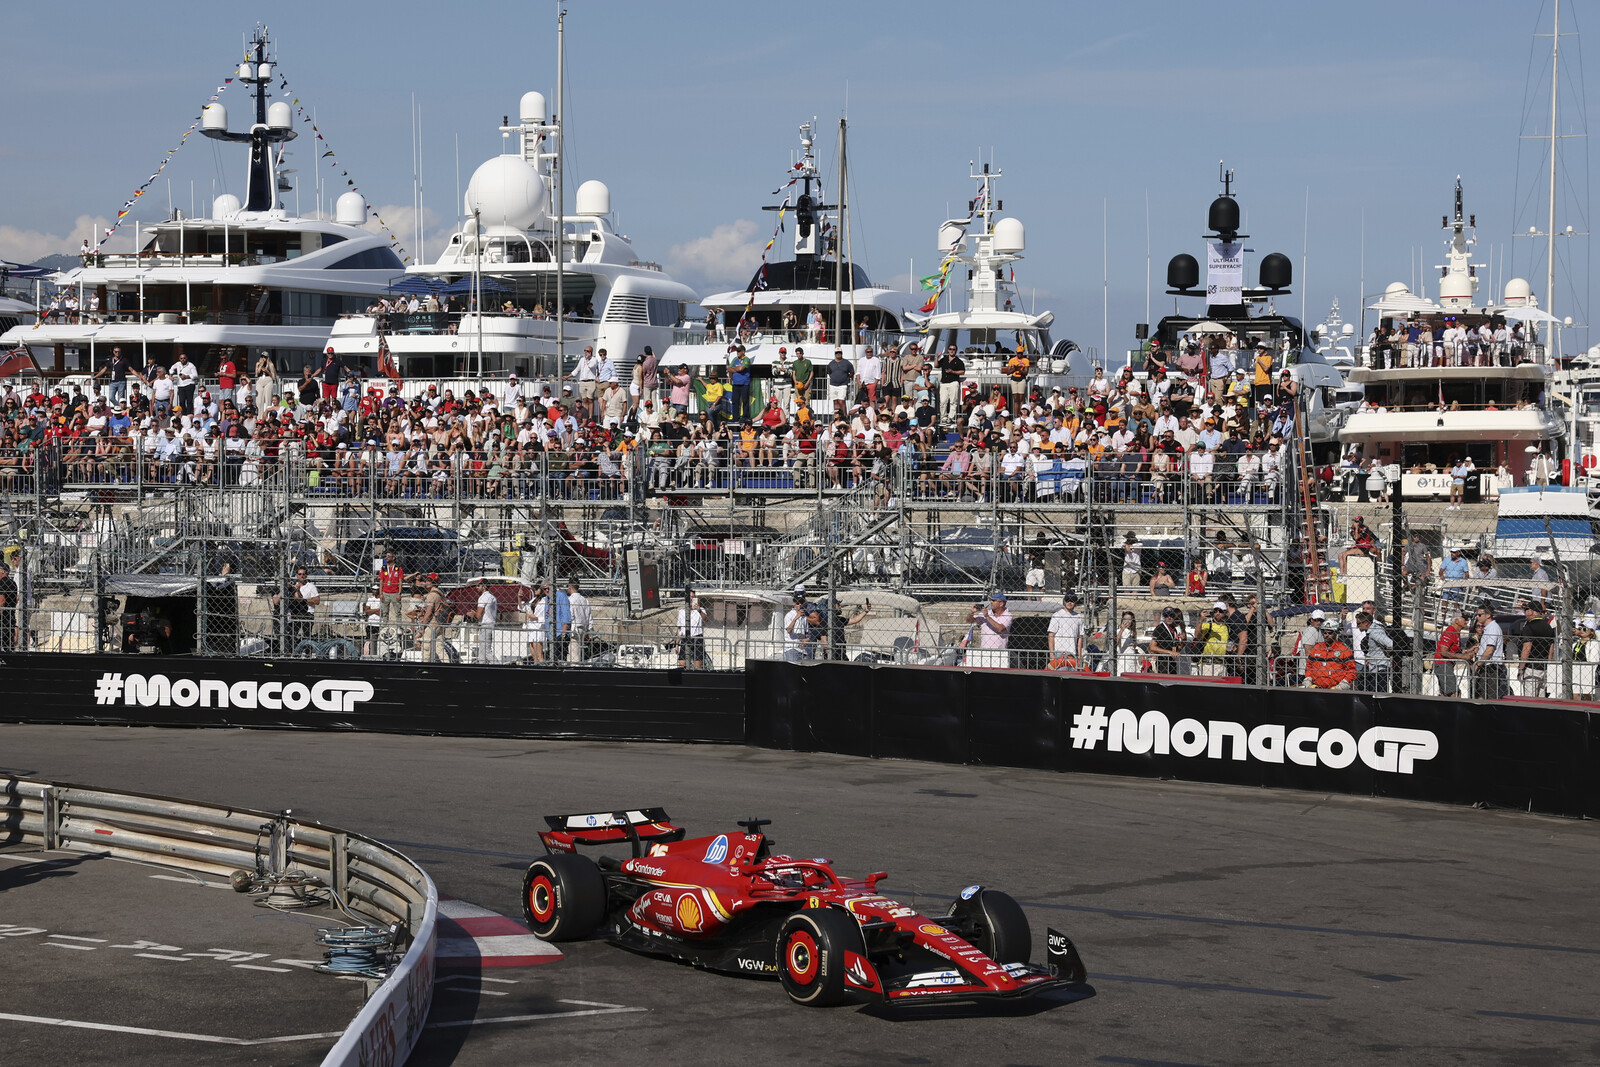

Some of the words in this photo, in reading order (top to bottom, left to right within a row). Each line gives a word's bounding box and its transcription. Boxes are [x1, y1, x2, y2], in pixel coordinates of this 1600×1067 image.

[549, 838, 572, 849] V-Power
[702, 835, 728, 863] hp
[634, 861, 666, 877] Santander
[654, 892, 672, 903] CEVA
[1048, 934, 1066, 947] aws
[928, 945, 951, 960] Santander
[737, 958, 764, 971] VGW
